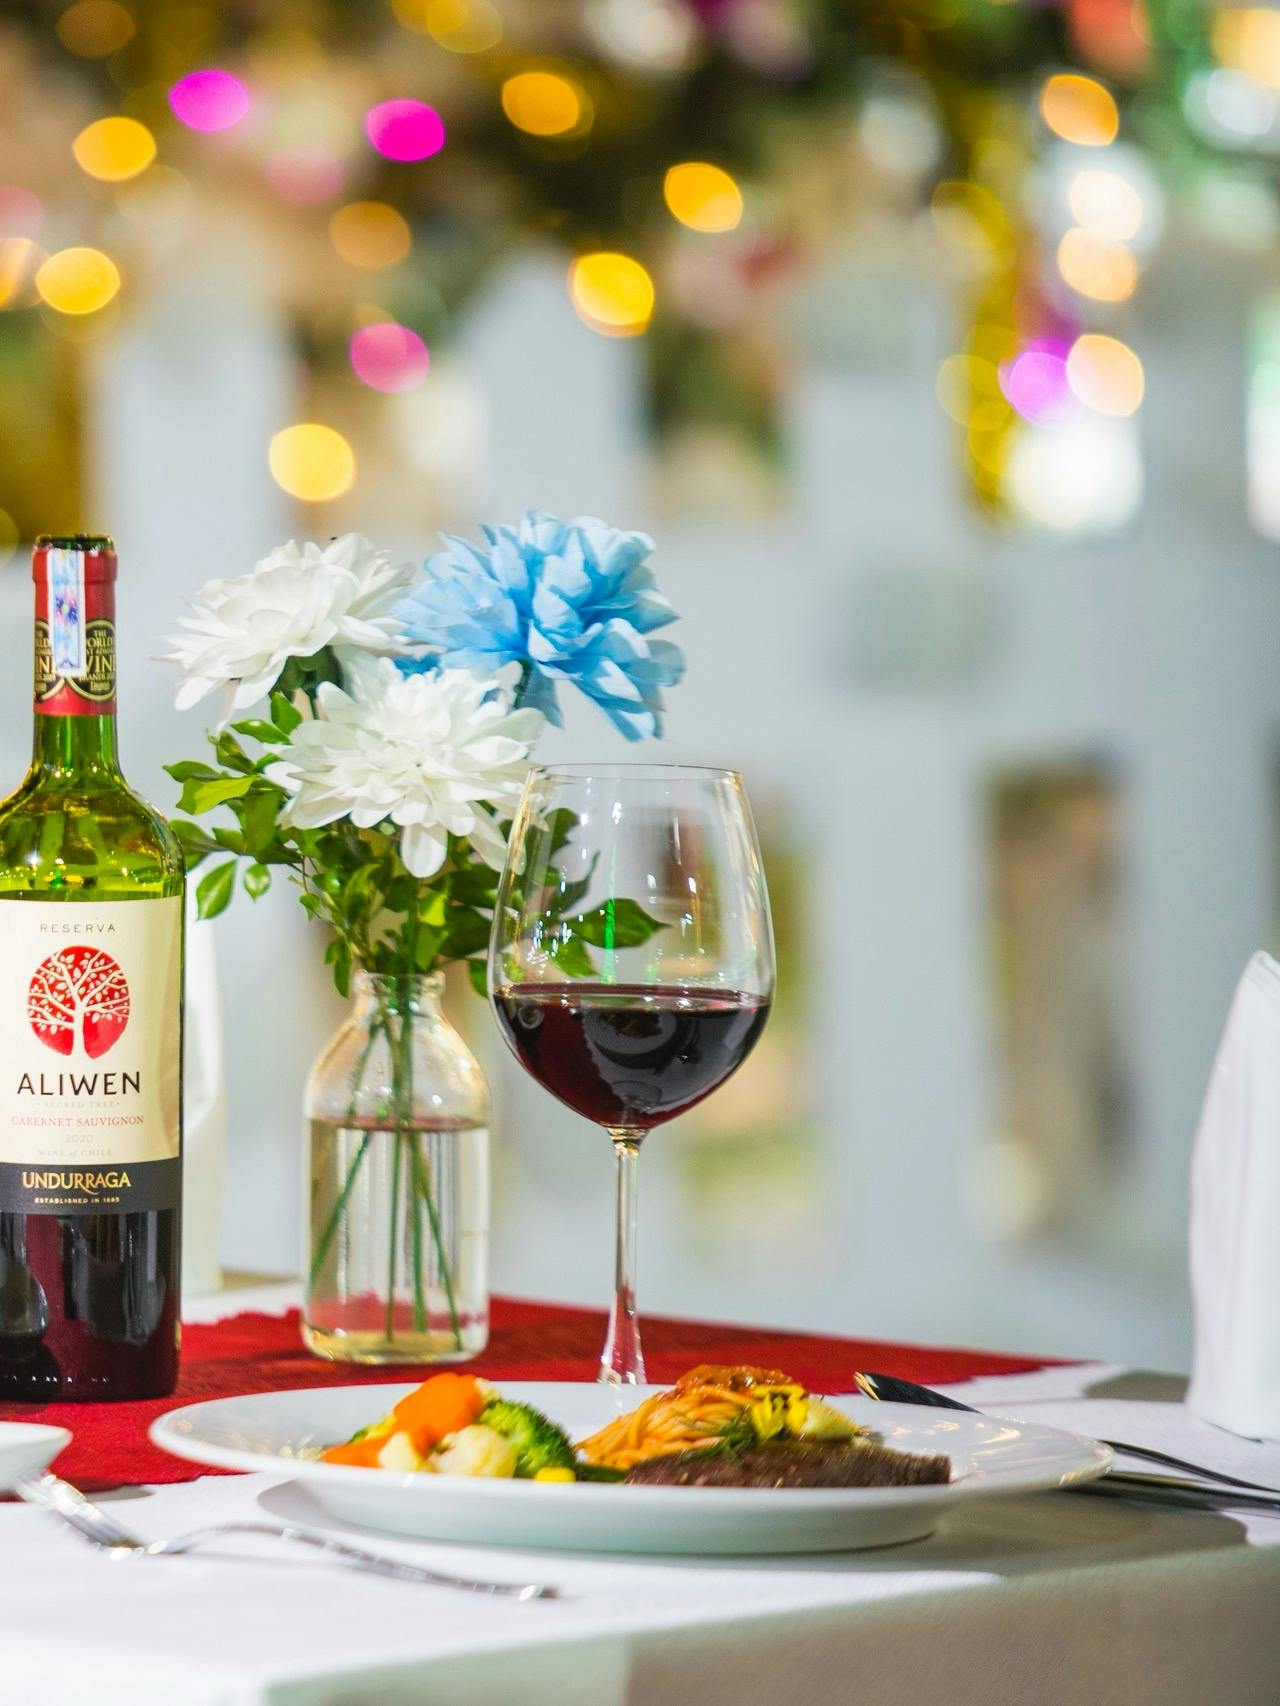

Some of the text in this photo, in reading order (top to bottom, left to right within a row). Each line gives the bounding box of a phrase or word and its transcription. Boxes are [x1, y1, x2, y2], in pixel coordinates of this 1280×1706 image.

[40, 923, 116, 934] RESERVA
[17, 1071, 140, 1095] ALIWEN
[11, 1115, 145, 1127] CABERNET SAUVIGNON
[64, 1134, 94, 1143] 2020
[22, 1171, 132, 1195] UNDURRAGA
